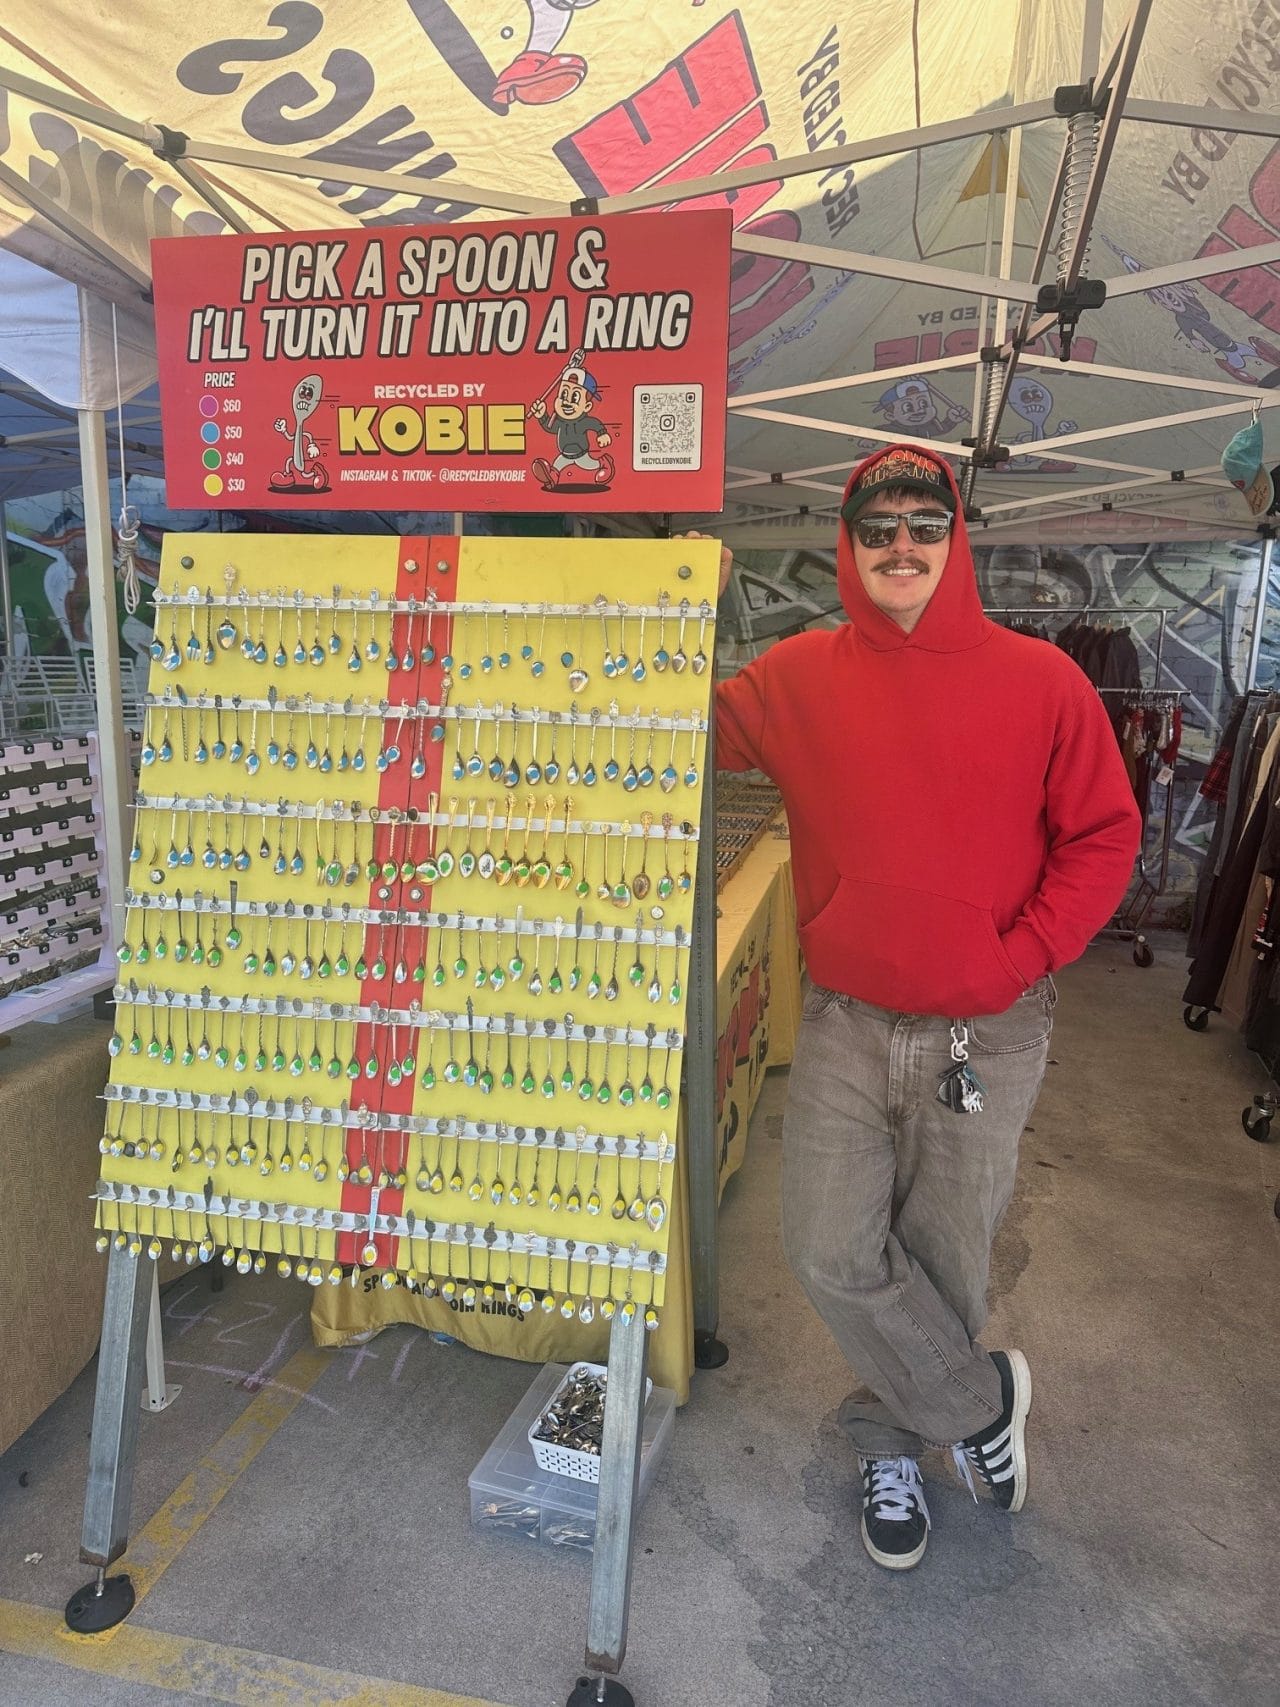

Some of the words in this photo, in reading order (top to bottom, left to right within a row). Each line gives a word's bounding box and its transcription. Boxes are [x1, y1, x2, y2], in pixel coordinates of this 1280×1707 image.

[242, 241, 348, 302] PICK
[353, 240, 385, 298] A
[397, 231, 558, 298] SPOON
[568, 227, 609, 292] &
[187, 305, 249, 361] I'LL
[263, 304, 368, 360] TURN
[378, 302, 422, 357] IT
[429, 297, 529, 356] INTO
[535, 296, 571, 354] A
[582, 292, 693, 352] RING
[204, 371, 236, 388] PRICE
[374, 384, 459, 399] RECYCLED
[463, 383, 486, 397] BY
[222, 398, 241, 414] $60
[224, 425, 243, 440] $50
[337, 404, 526, 456] KOBIE
[225, 452, 244, 466] $40
[641, 457, 692, 465] RECYCLEDBYKOBIE
[340, 469, 388, 482] INSTAGRAM
[391, 469, 399, 482] &
[439, 467, 527, 483] @RECYCLEDBYKOBIE
[227, 478, 246, 493] $30
[449, 1298, 475, 1312] OIN
